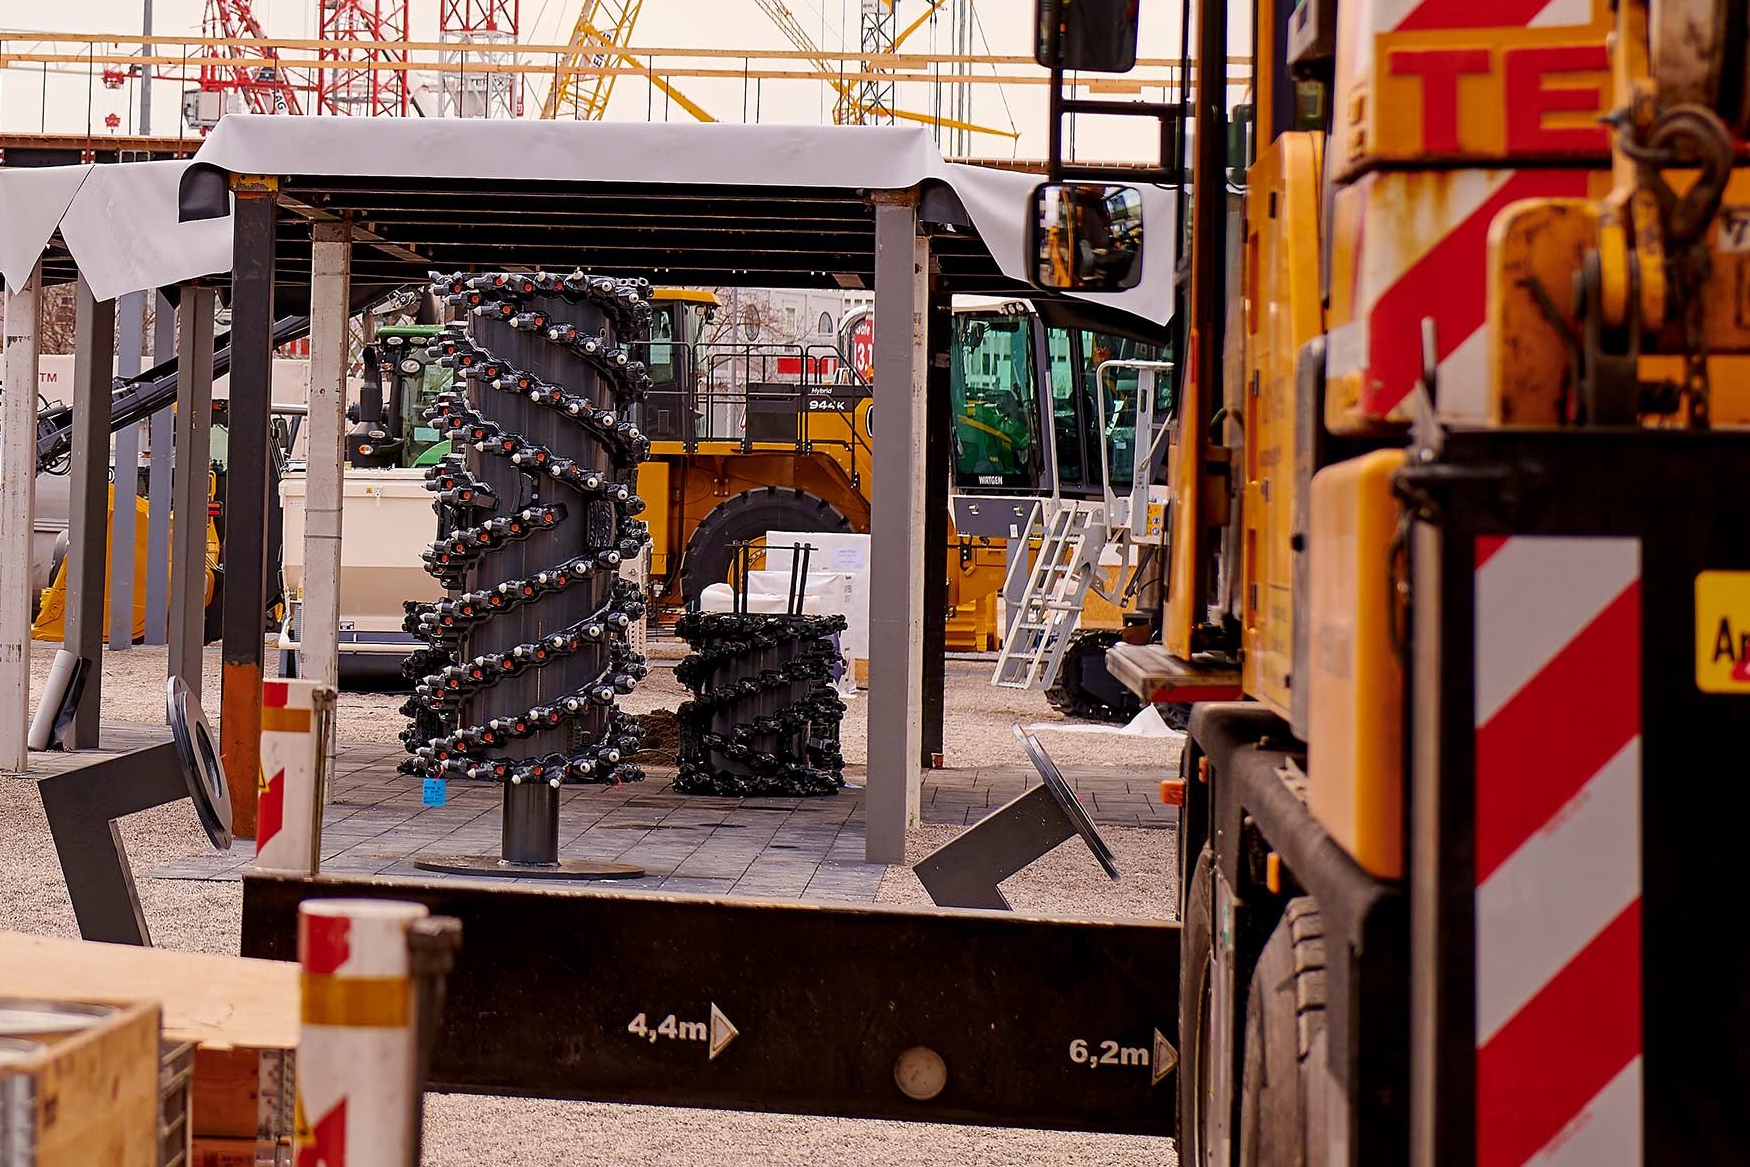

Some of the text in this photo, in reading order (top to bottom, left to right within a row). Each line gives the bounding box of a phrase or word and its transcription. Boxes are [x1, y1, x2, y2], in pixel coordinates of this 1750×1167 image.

[811, 387, 832, 395] Hybrid
[978, 475, 1003, 485] WIRTGEN
[627, 1012, 708, 1044] 4,4m
[1069, 1038, 1150, 1069] 6,2m
